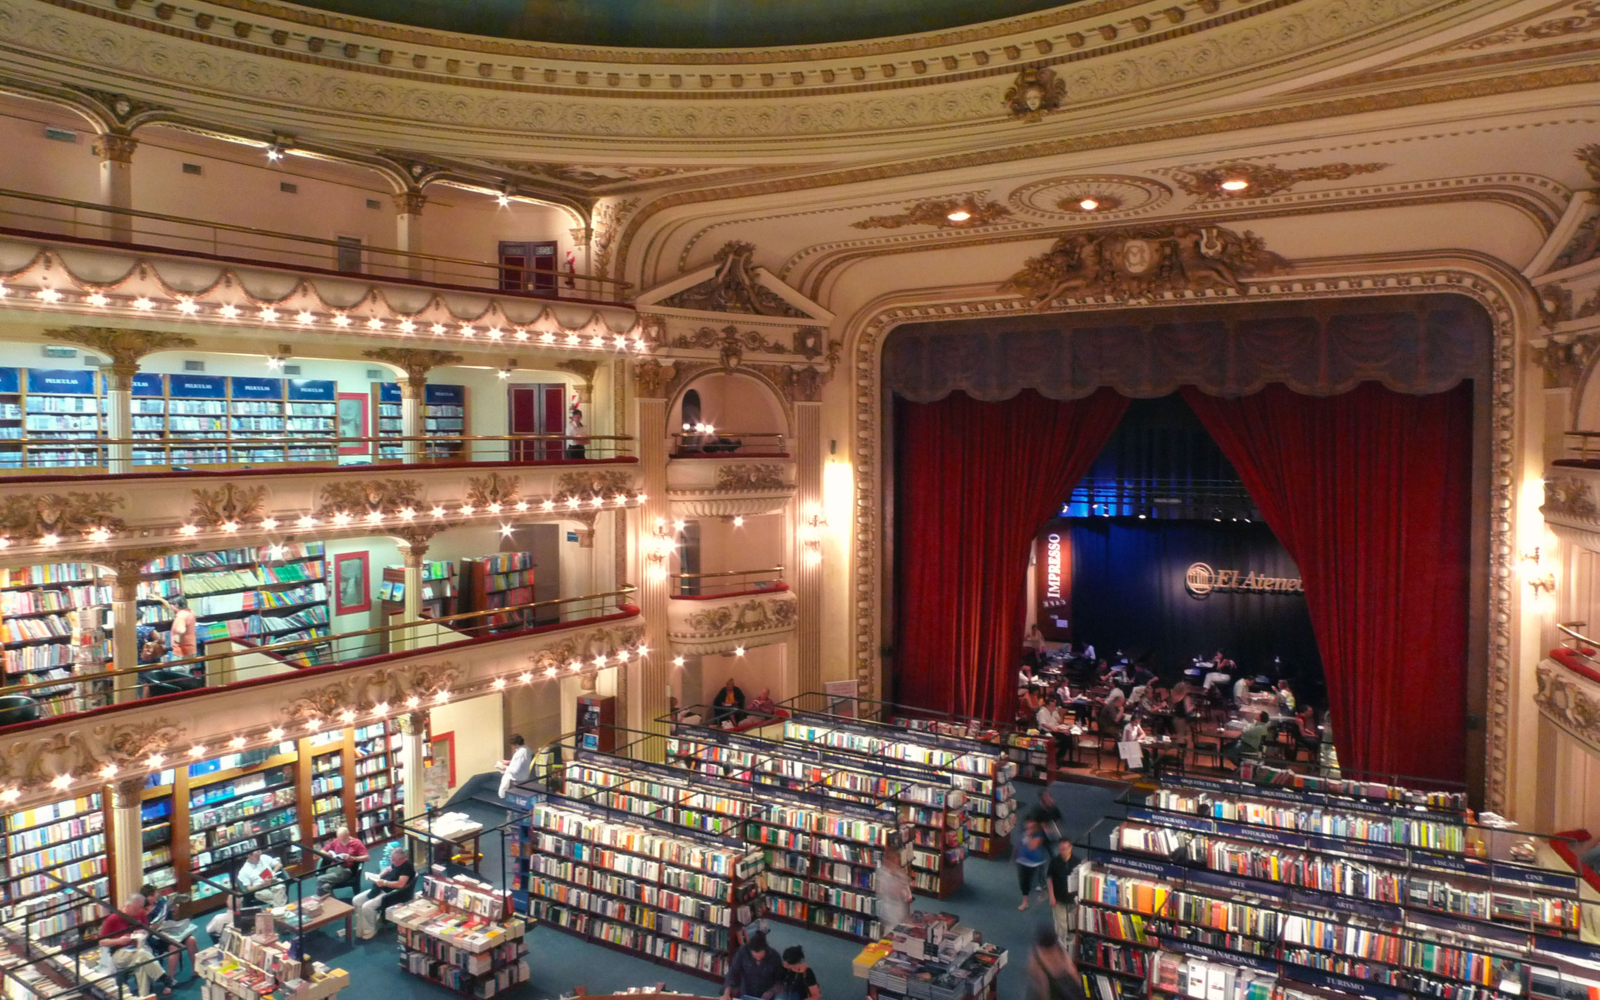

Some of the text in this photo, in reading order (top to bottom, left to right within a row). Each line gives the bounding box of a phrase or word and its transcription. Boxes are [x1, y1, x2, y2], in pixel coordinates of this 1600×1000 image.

[1047, 533, 1061, 598] IMPRESSO
[1217, 569, 1239, 588] El
[1261, 790, 1304, 801] ARQUITECTURA
[1241, 828, 1279, 840] FOTOGRAFIA
[1343, 844, 1373, 855] VISUALES
[1111, 856, 1164, 872] ARTE ARGENTINO
[1433, 859, 1465, 870] VISUALES
[1525, 873, 1544, 881] CINE
[1228, 880, 1246, 888] ARTE
[1336, 901, 1355, 910] ARTE
[1456, 923, 1477, 932] ARTE
[1182, 942, 1258, 967] TURISMO NACIONAL
[1326, 976, 1365, 991] TURISMO
